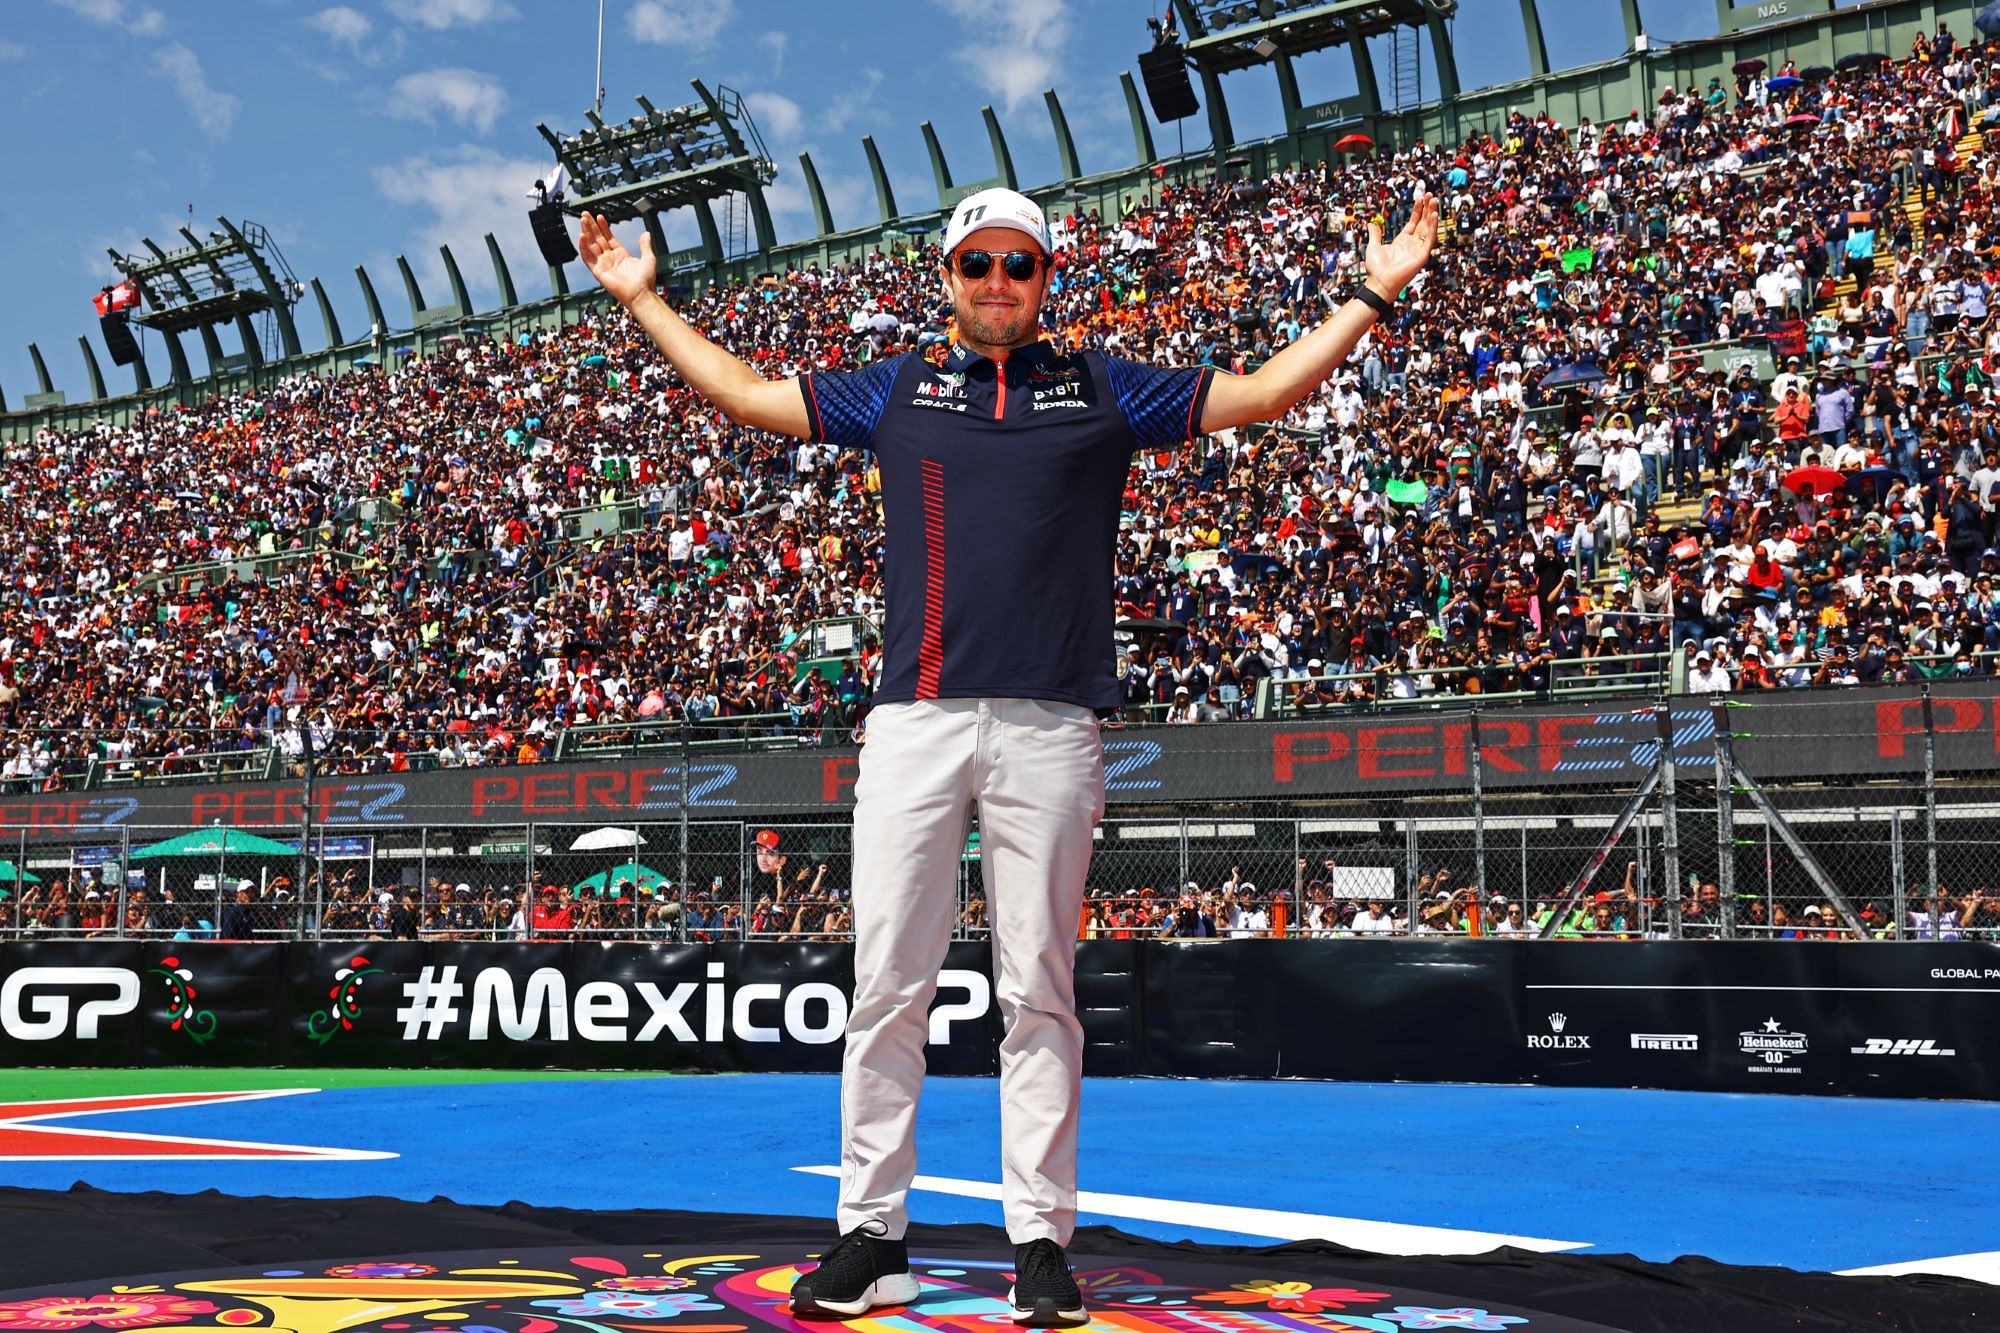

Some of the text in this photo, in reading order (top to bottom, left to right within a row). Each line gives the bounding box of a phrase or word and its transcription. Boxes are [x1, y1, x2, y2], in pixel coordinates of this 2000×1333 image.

[1316, 104, 1339, 118] NA7
[963, 204, 987, 227] 11
[1722, 355, 1758, 370] VE3
[916, 381, 954, 398] Mobil
[1034, 382, 1081, 401] BYBIT
[912, 399, 968, 412] ORACLE
[1032, 400, 1088, 411] HONDA
[1273, 710, 1717, 783] PEREZ
[471, 763, 738, 817] PEREZ
[1930, 968, 1983, 979] GLOBAL
[397, 962, 990, 1045] #MexicoP
[1527, 1035, 1591, 1049] ROLEX
[1630, 1033, 1699, 1051] PIRELLI
[1743, 1036, 1804, 1049] Heineken
[1864, 1038, 1941, 1055] DHL
[1765, 1051, 1783, 1064] 0.0
